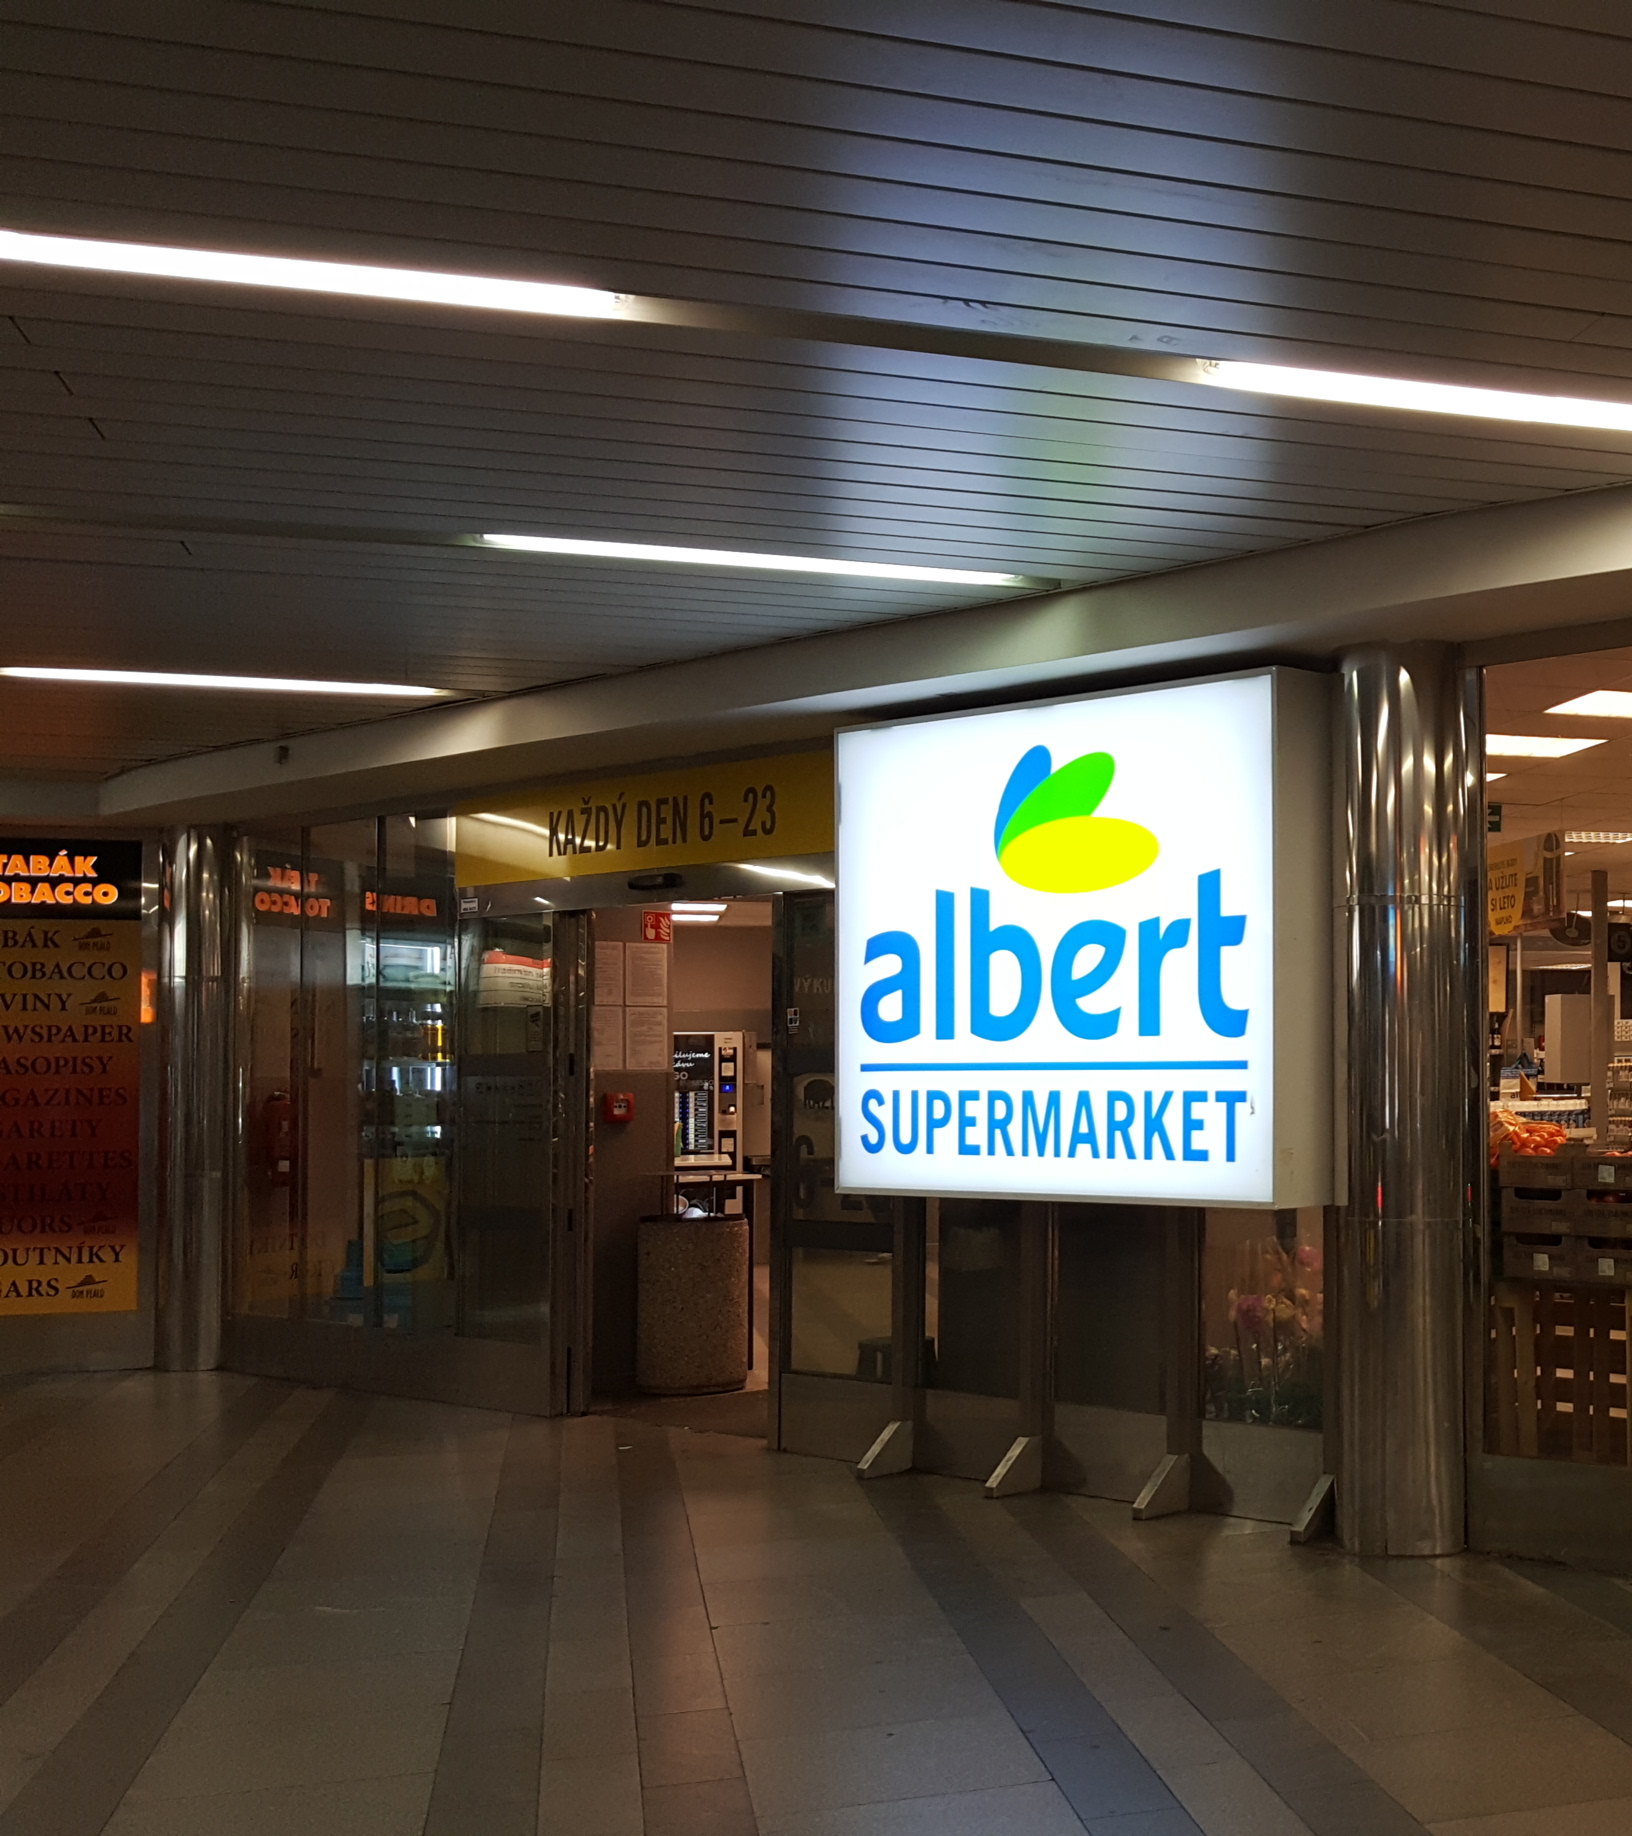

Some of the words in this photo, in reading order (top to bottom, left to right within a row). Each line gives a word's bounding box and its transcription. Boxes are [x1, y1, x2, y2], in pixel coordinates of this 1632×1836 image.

[548, 792, 627, 858] KAŽDÝ
[636, 795, 688, 848] DEN
[859, 867, 1250, 1044] albert
[0, 1119, 103, 1140] ARETY
[0, 1278, 60, 1298] ARS
